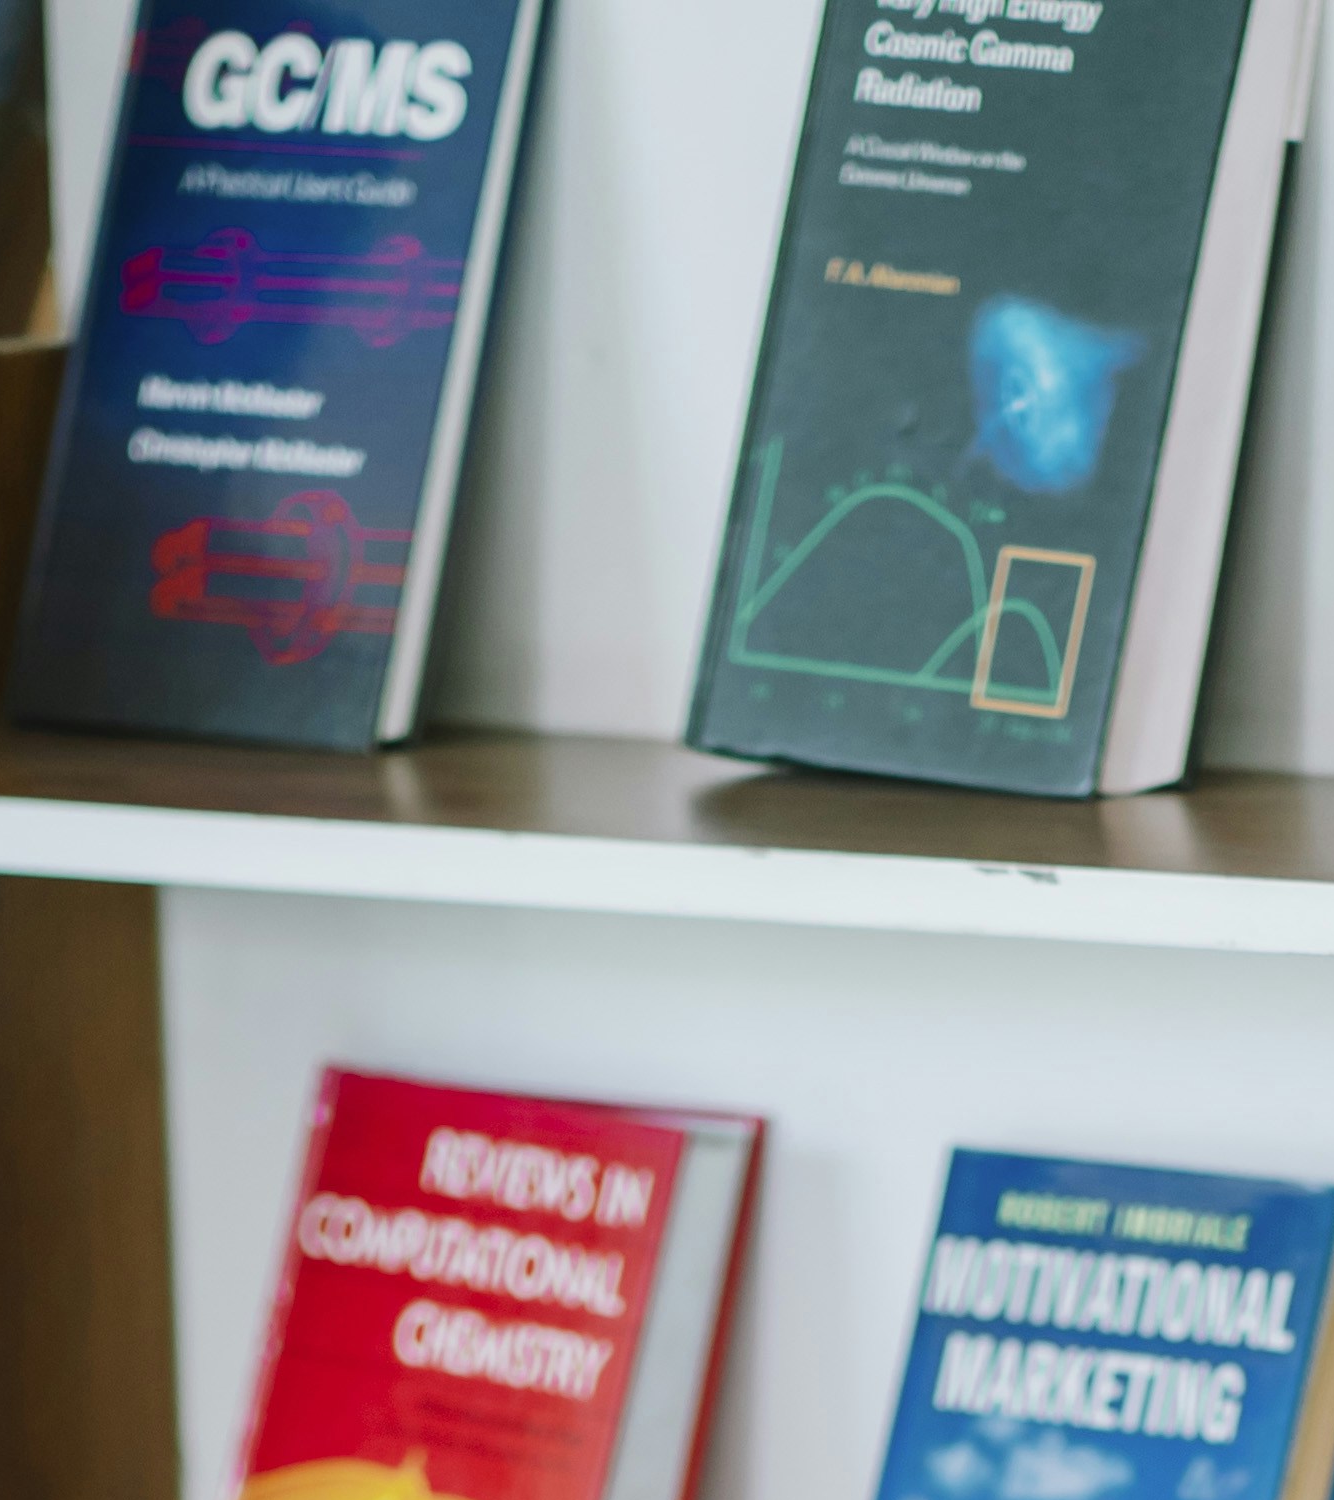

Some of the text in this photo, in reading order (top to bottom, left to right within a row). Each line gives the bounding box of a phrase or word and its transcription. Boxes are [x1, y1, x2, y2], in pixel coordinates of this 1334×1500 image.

[864, 20, 1075, 73] Cosmic Gamma
[853, 67, 982, 113] Radiation
[594, 1160, 656, 1227] IN
[922, 1234, 1298, 1354] MOTIVATIONAL
[392, 1297, 615, 1402] CHEMISTRY
[932, 1330, 1249, 1445] MARKETING
